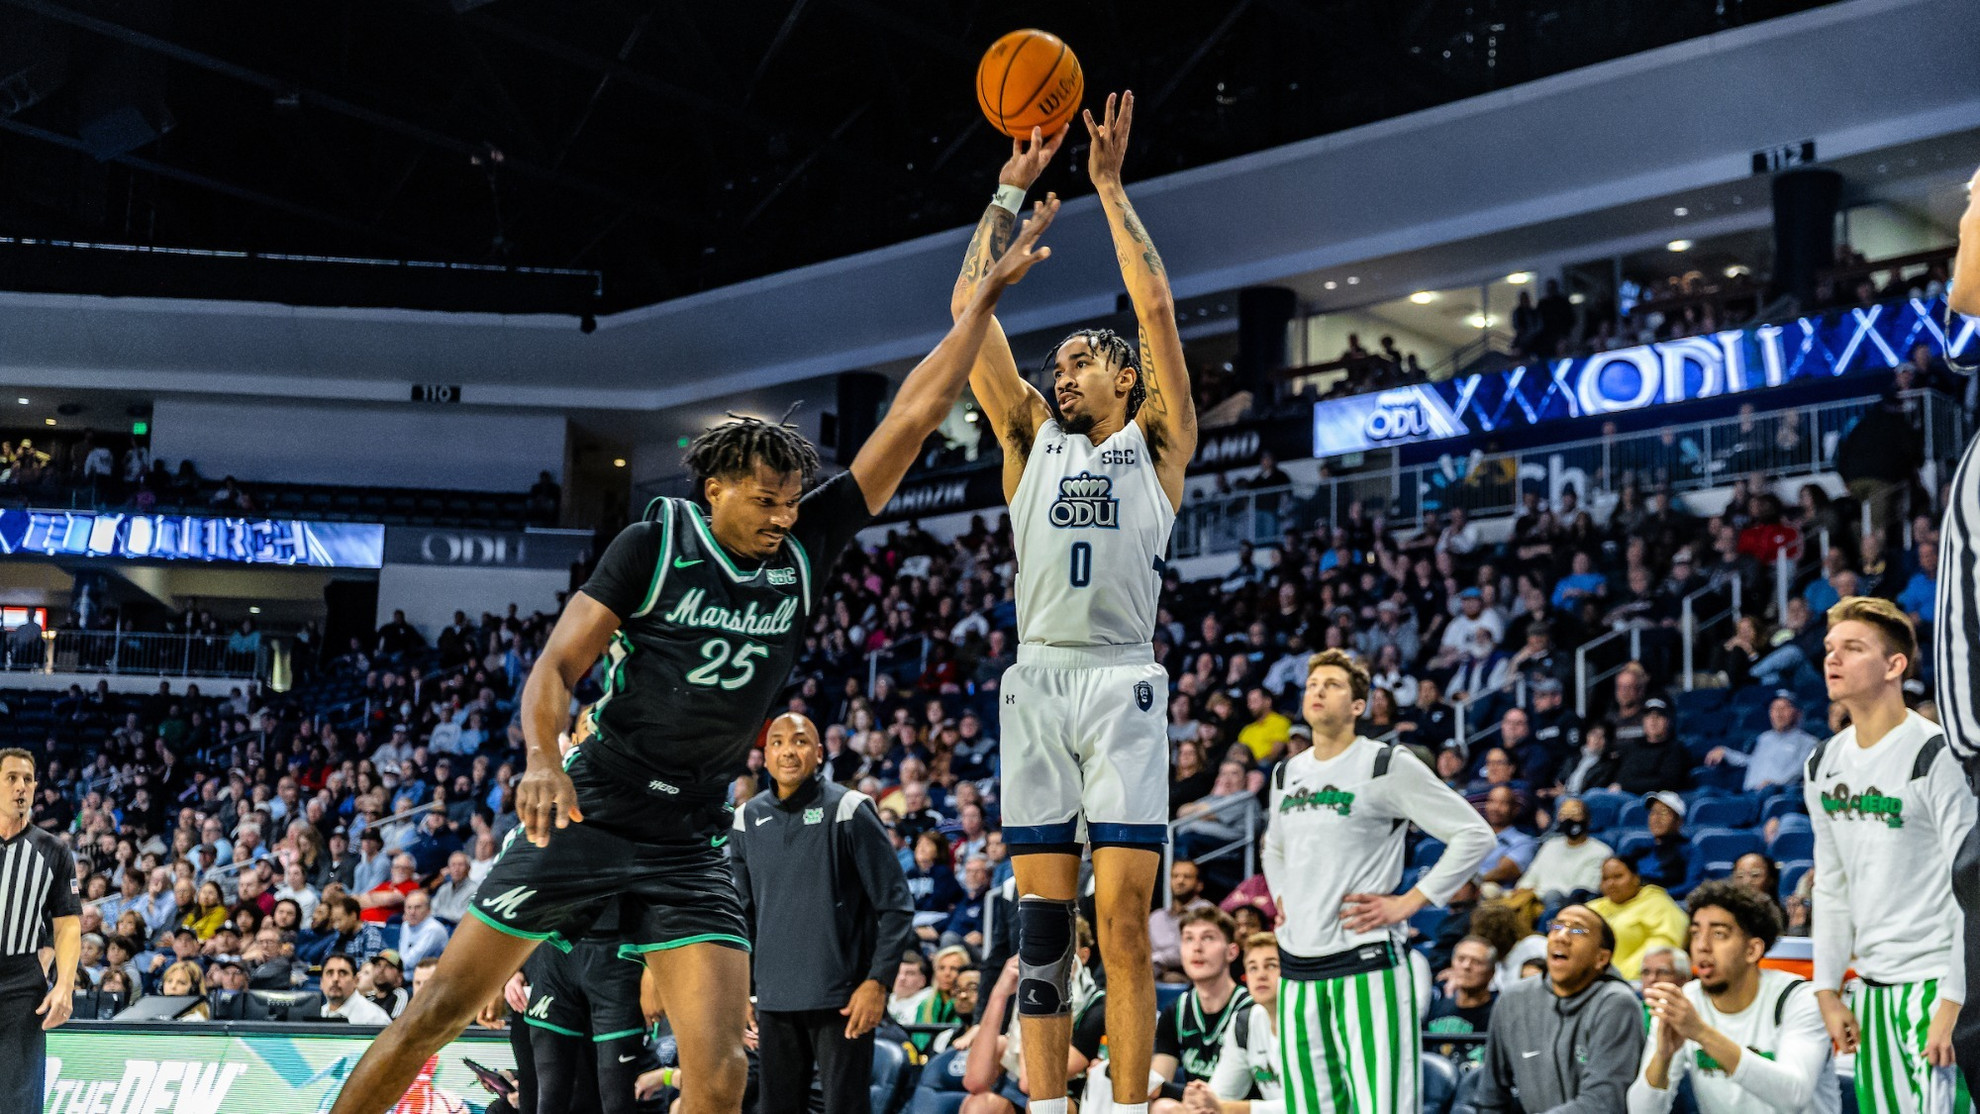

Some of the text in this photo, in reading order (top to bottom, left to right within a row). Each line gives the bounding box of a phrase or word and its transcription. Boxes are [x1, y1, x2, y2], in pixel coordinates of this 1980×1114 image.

[423, 384, 452, 402] 110
[1365, 404, 1430, 441] ODU
[1050, 500, 1119, 528] ODU
[1070, 541, 1092, 588] 0
[665, 587, 799, 635] Marshall
[686, 638, 769, 690] 25
[482, 885, 538, 919] M
[528, 995, 554, 1019] M
[46, 1079, 119, 1114] THE
[107, 1060, 247, 1114] DEW
